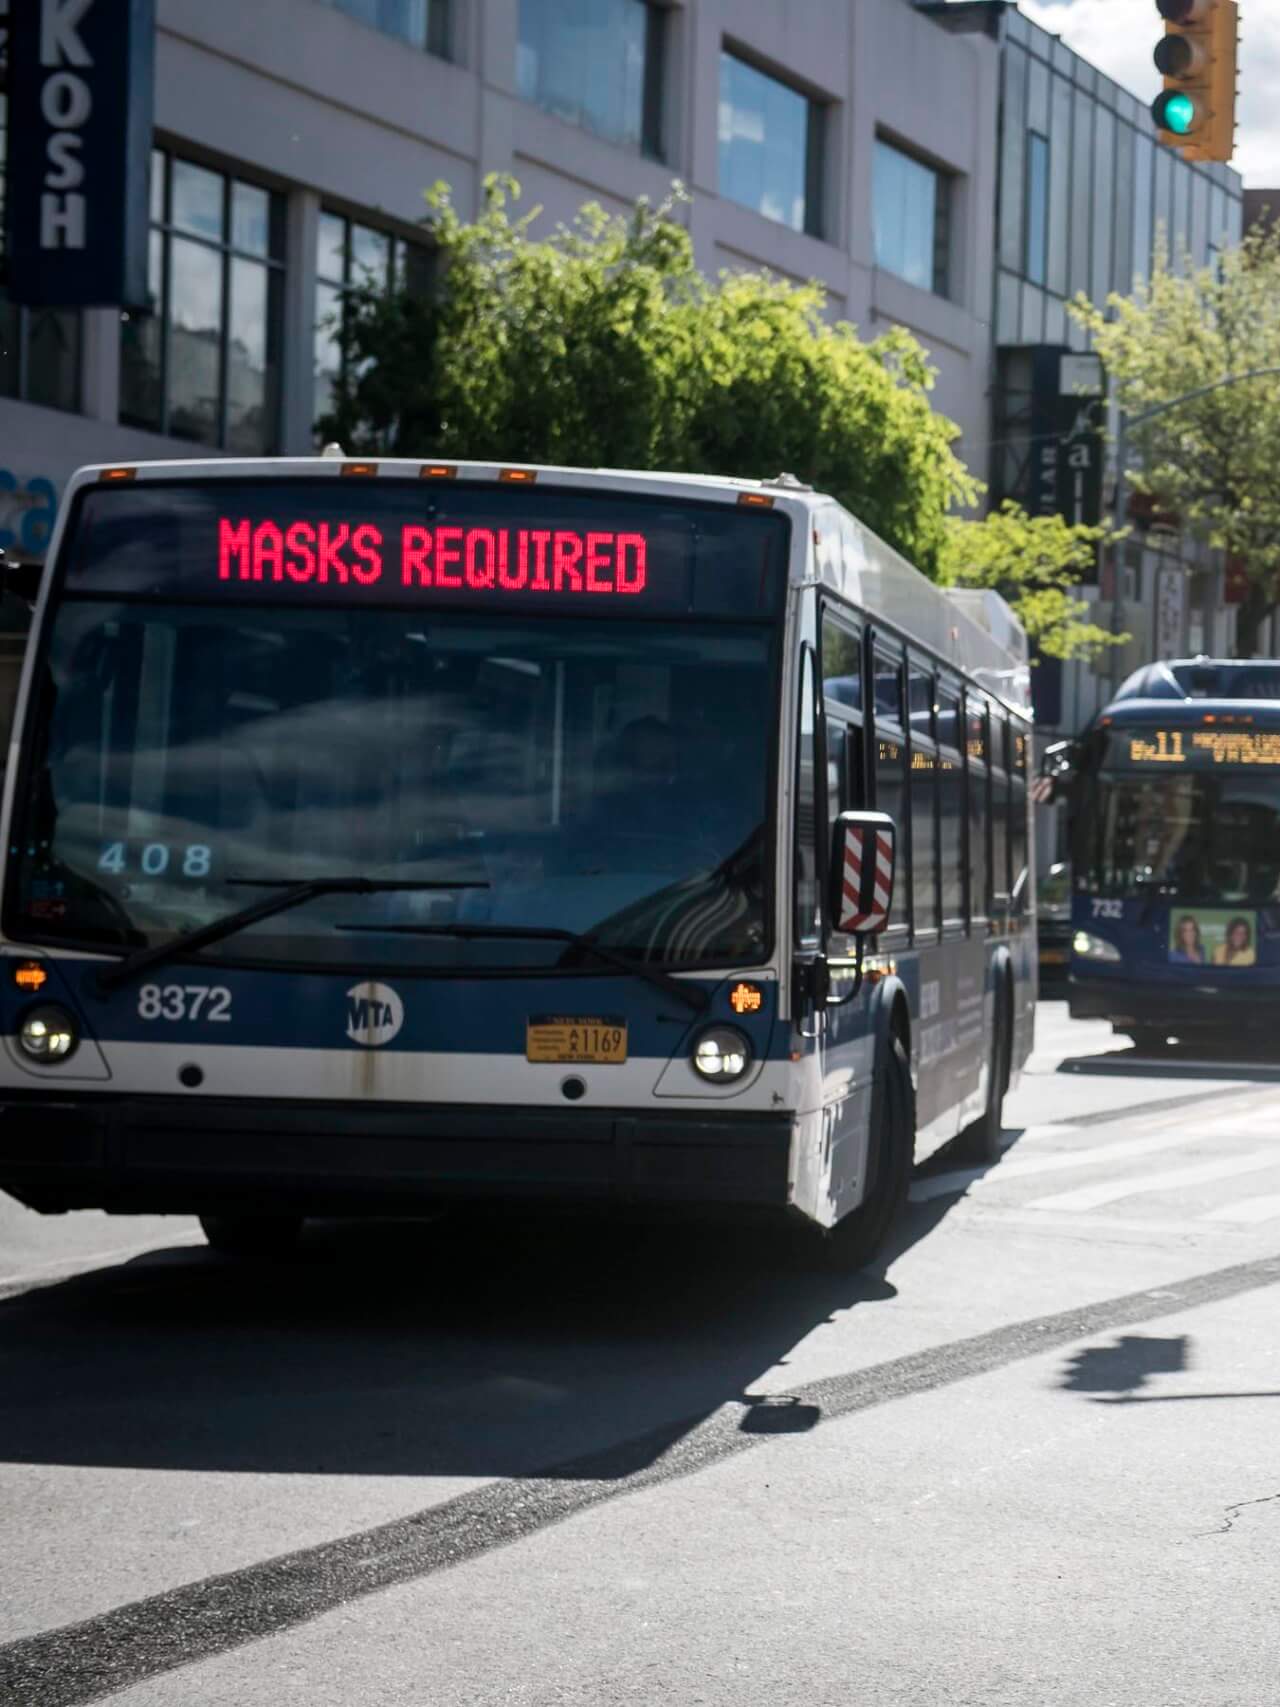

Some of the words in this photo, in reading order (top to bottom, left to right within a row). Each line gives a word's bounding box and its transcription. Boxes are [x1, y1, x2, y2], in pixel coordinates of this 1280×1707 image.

[218, 518, 382, 585] MASKS
[402, 524, 647, 594] REQUIRED
[138, 984, 233, 1021] 8372
[345, 998, 394, 1032] MTA
